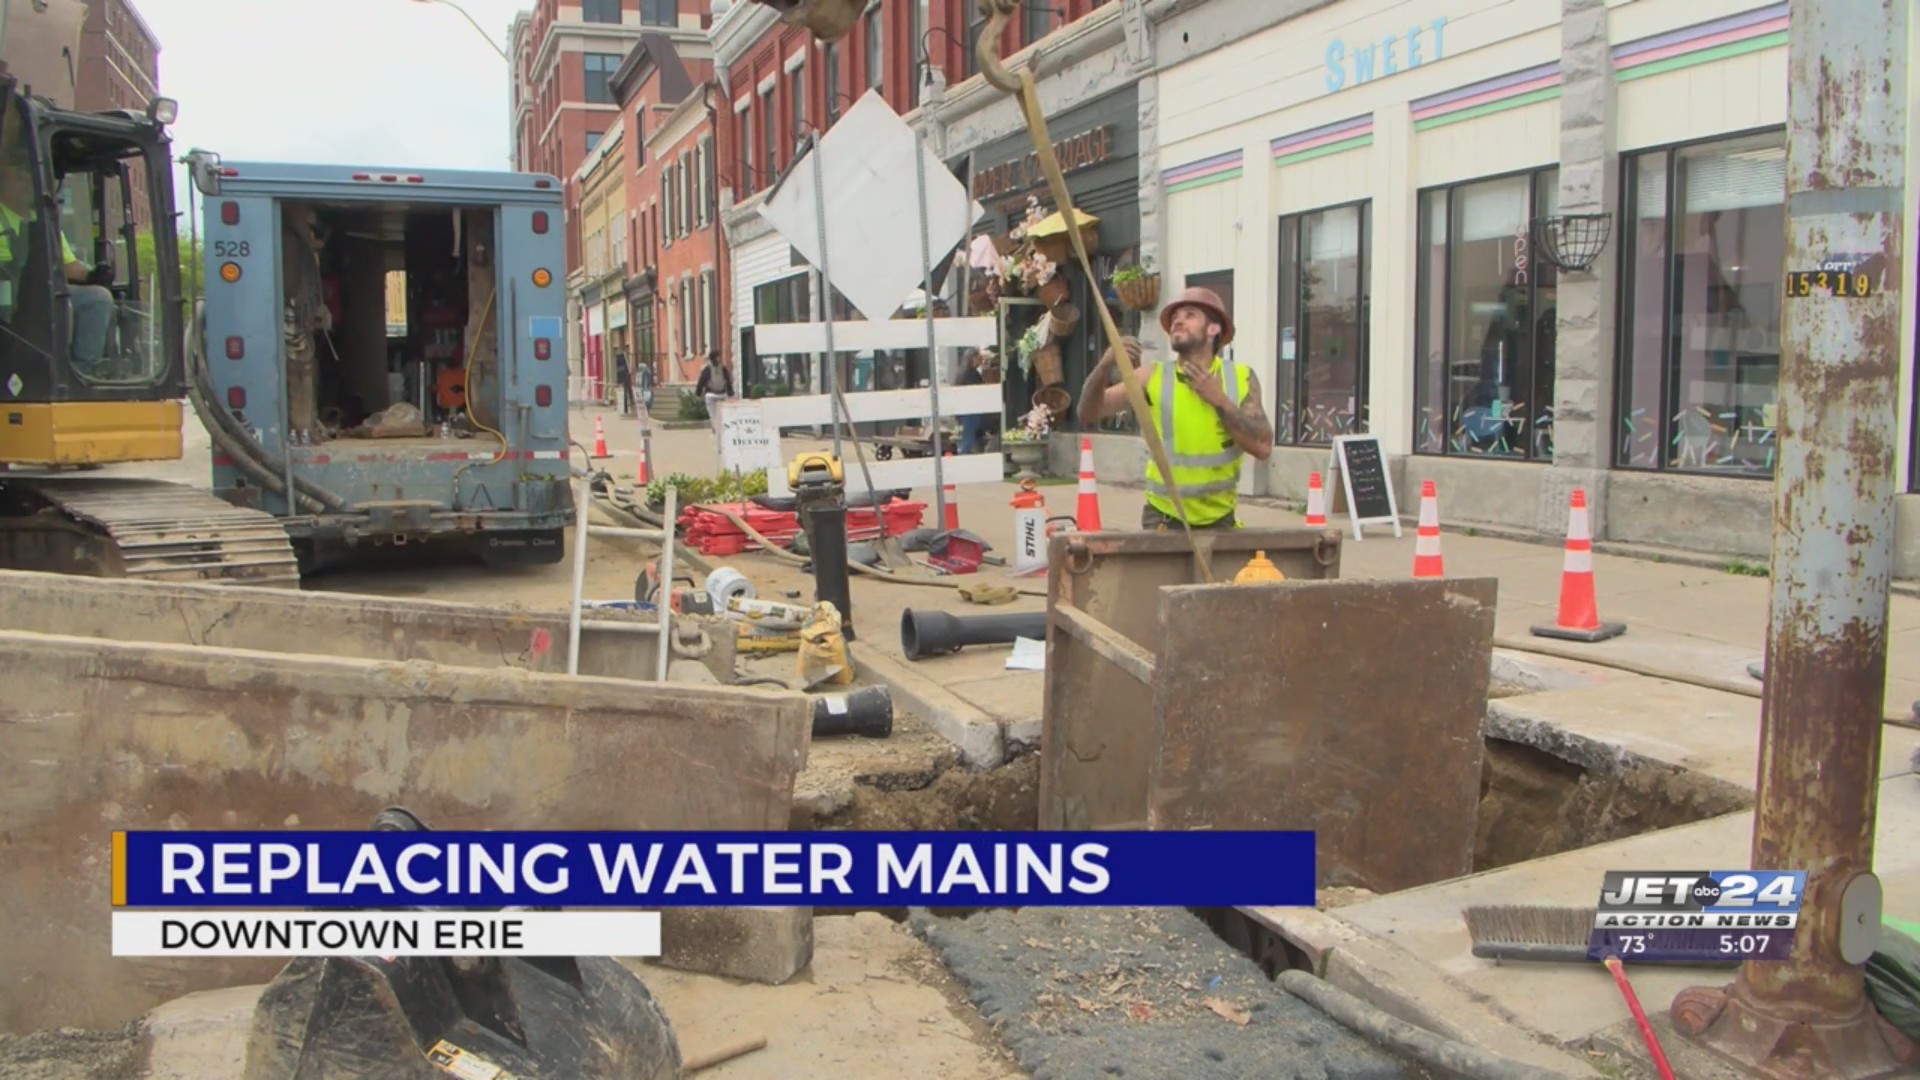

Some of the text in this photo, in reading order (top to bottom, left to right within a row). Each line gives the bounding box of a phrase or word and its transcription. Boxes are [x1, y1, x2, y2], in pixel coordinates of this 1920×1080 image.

[1325, 16, 1449, 94] SWEET
[1021, 123, 1113, 185] CARIAGE
[214, 240, 251, 257] 528
[1025, 517, 1036, 558] STIHL
